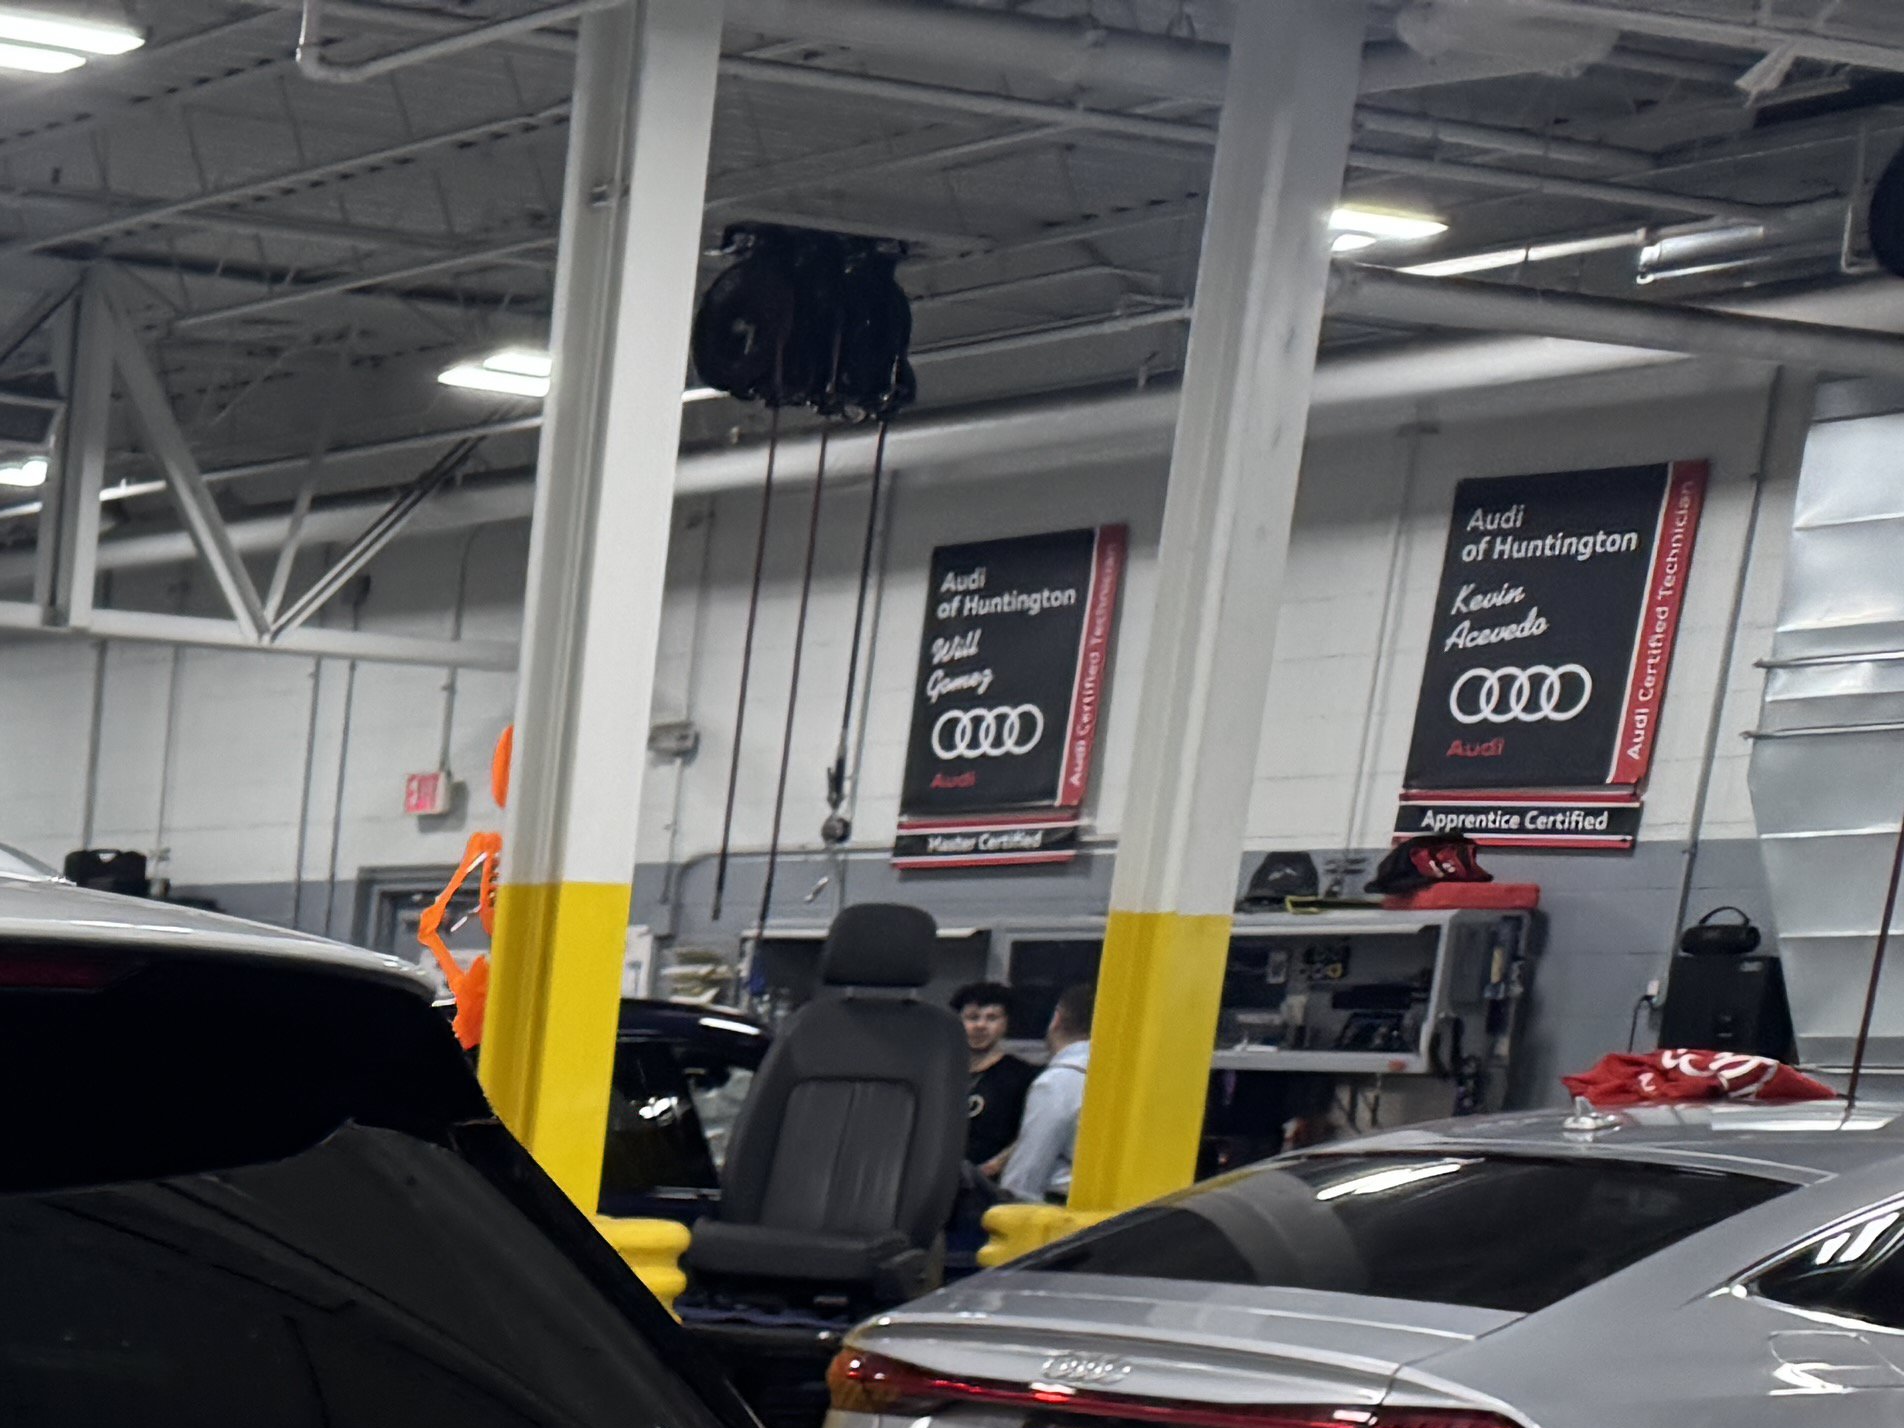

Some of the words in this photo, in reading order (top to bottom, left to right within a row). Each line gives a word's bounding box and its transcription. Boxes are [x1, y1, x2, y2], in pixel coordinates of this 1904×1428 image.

[1466, 504, 1525, 531] Audi
[1461, 536, 1491, 562] of
[1493, 530, 1638, 562] Huntington
[940, 566, 986, 593] Audi
[936, 595, 961, 620] of
[963, 588, 1076, 617] Huntington
[1450, 582, 1526, 615] Kevin
[1444, 606, 1549, 652] Acevedo
[1626, 708, 1650, 760] Audi
[1638, 606, 1670, 702] Certified
[1657, 480, 1694, 601] Technician
[932, 628, 982, 666] Will
[1446, 737, 1505, 758] Audi
[1421, 809, 1521, 833] Apprentice
[1524, 810, 1609, 831] Certified
